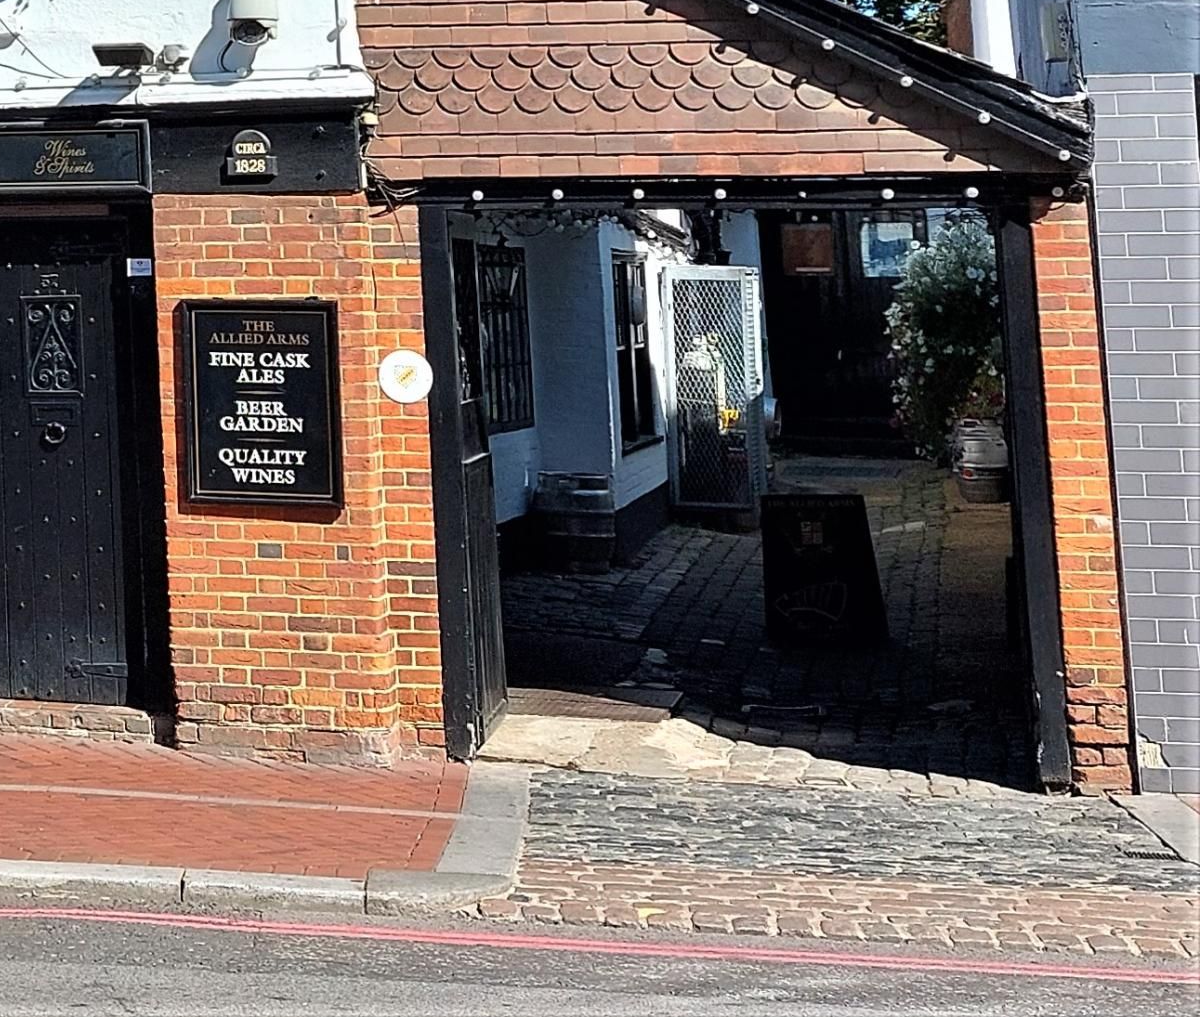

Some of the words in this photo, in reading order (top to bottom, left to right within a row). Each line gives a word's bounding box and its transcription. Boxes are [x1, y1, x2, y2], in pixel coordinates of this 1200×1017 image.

[44, 139, 87, 157] Wines
[235, 142, 267, 155] CIRCA
[235, 158, 266, 174] 1828
[242, 320, 275, 332] THE
[209, 333, 264, 345] ALLIED
[266, 334, 310, 346] ARMS
[208, 352, 254, 367] FINE
[259, 352, 311, 368] CASK
[236, 369, 285, 384] ALES
[235, 400, 288, 416] BEER
[219, 416, 304, 433] GARDEN
[218, 448, 307, 466] QUALITY
[231, 467, 295, 484] WINES
